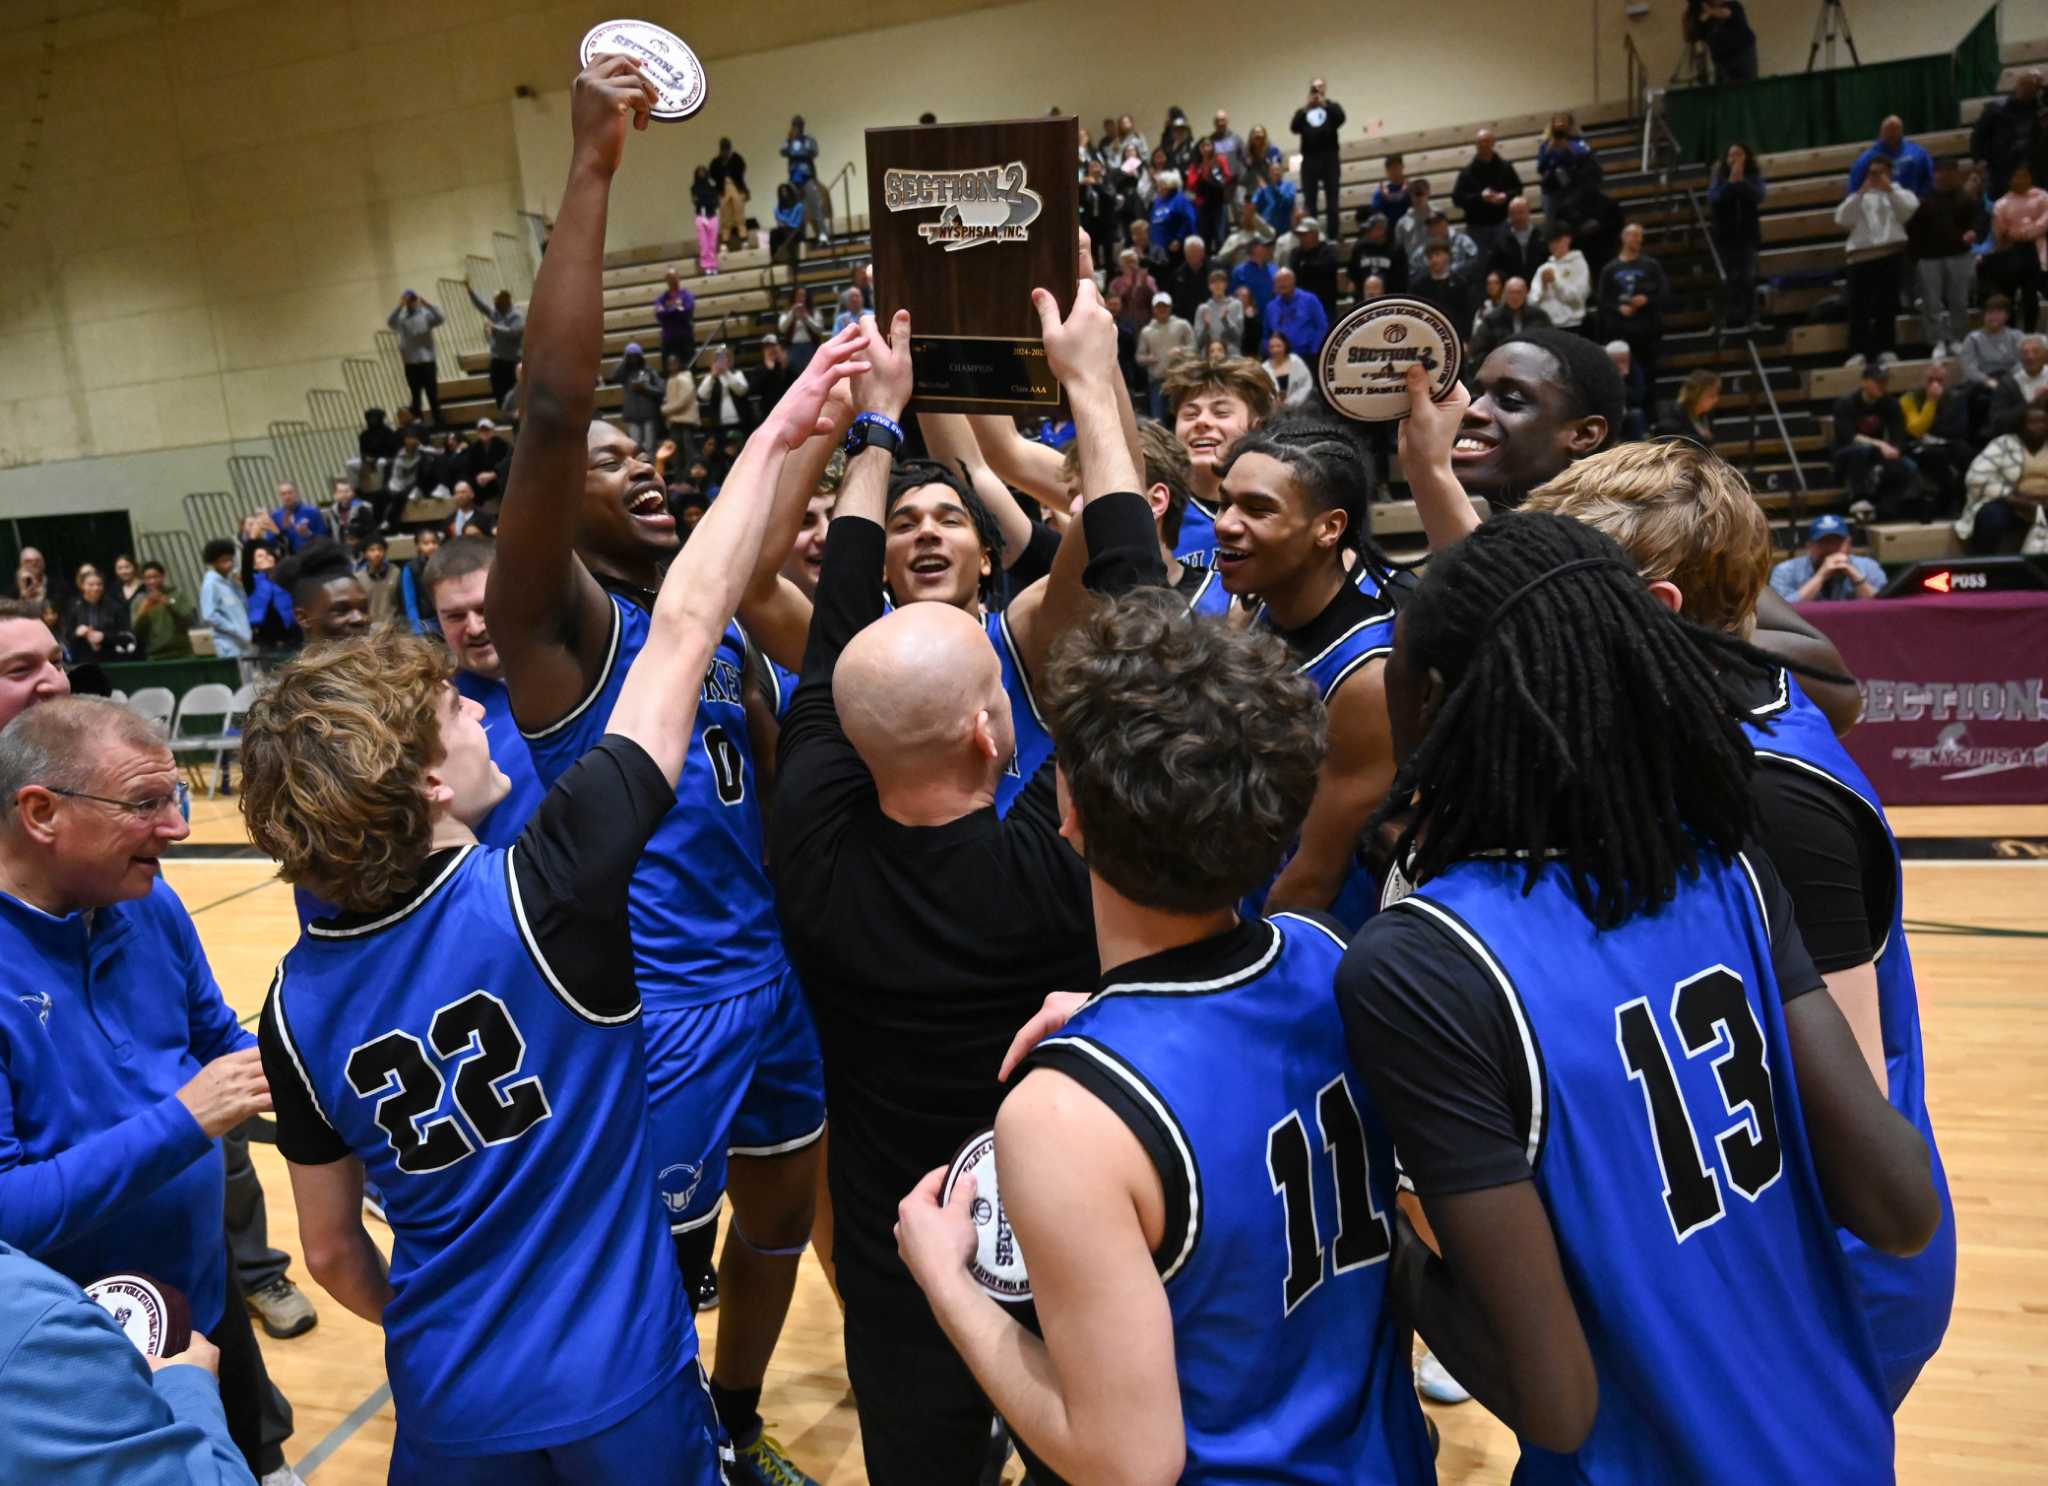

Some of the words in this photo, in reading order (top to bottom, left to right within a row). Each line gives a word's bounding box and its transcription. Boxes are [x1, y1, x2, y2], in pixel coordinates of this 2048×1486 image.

[886, 171, 1001, 206] SECTION
[1004, 163, 1025, 202] 2
[1003, 225, 1026, 238] INC.
[1348, 347, 1418, 363] SECTION
[870, 414, 890, 428] GIVE
[1951, 573, 1987, 588] POSS
[1856, 680, 2042, 723] ECTION
[703, 725, 744, 807] 0
[344, 989, 552, 1174] 22
[1615, 963, 1782, 1245] 13
[1266, 1072, 1392, 1319] 11
[107, 1285, 122, 1293] NEW
[124, 1285, 141, 1297] YORK
[138, 1293, 154, 1313] STATE
[148, 1312, 157, 1341] PUBLIC
